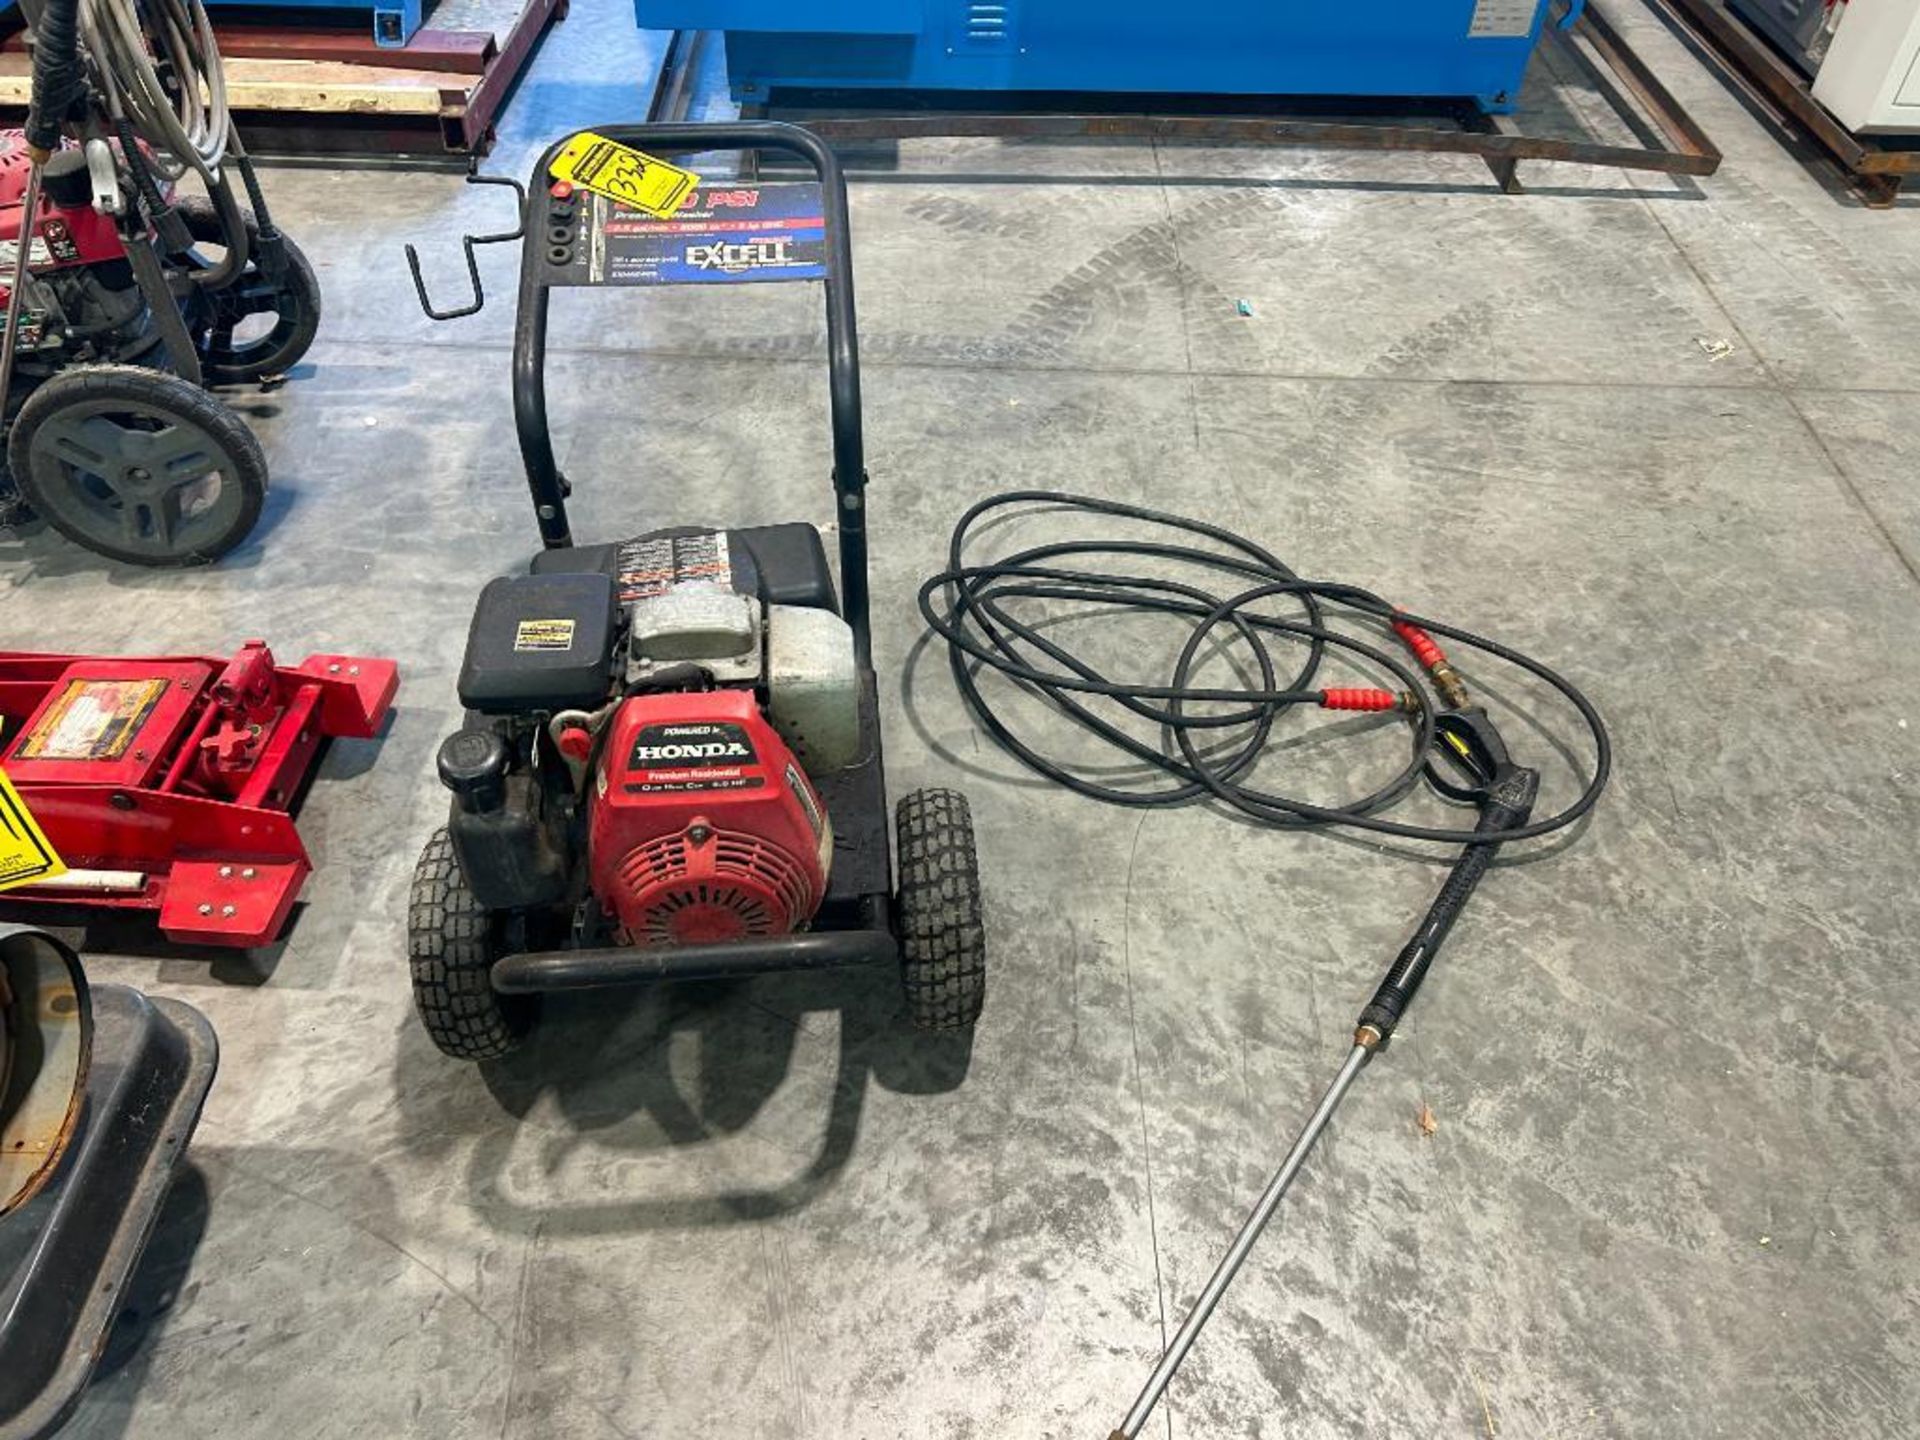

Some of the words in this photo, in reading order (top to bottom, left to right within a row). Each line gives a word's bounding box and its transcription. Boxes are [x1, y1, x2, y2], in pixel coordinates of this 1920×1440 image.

[706, 190, 759, 209] PSI
[686, 241, 793, 269] EXCELL
[637, 743, 750, 760] HONDA
[648, 771, 690, 781] Premium
[690, 768, 741, 779] Residential
